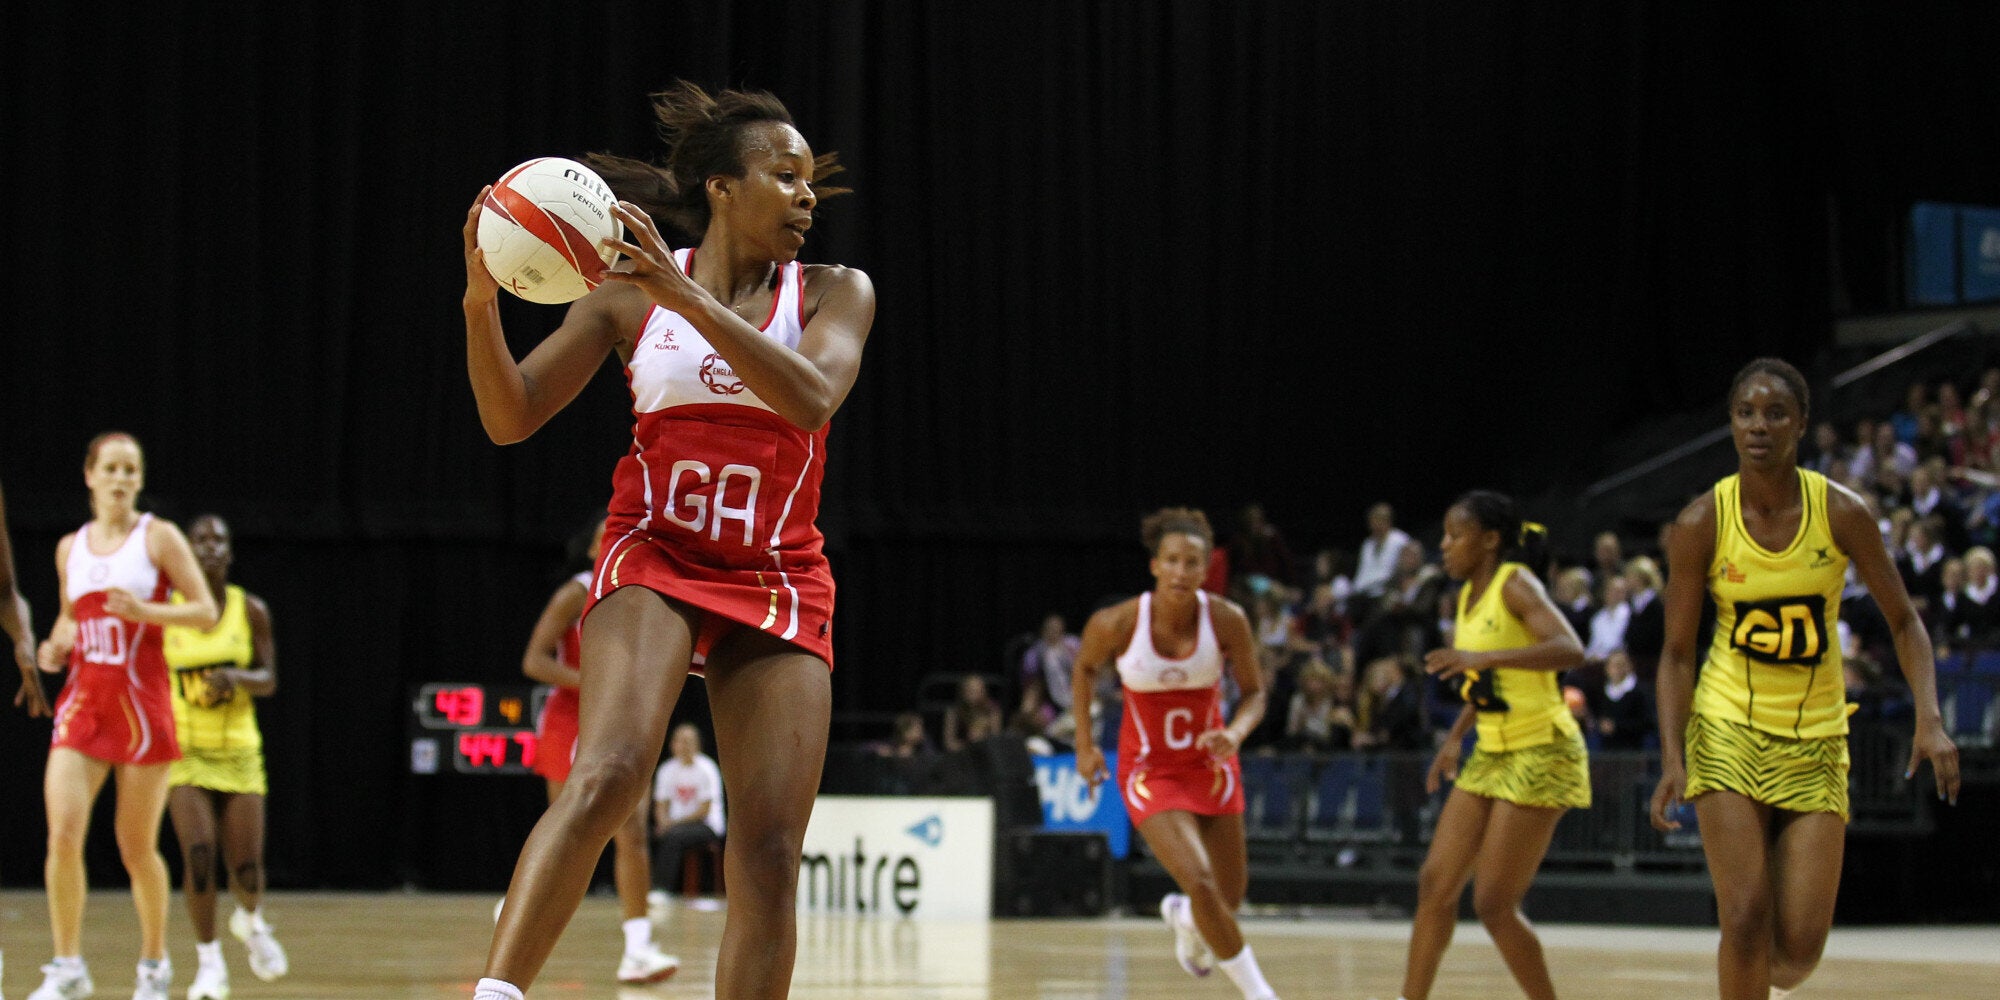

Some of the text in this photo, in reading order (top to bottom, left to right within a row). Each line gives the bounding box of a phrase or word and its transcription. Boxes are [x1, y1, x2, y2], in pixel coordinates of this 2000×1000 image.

[572, 190, 604, 220] VENTURI
[655, 343, 680, 351] KUKRI
[663, 460, 761, 546] GA
[435, 687, 484, 725] 43
[1164, 708, 1194, 750] C
[459, 733, 507, 767] 44
[800, 836, 920, 913] mitre
